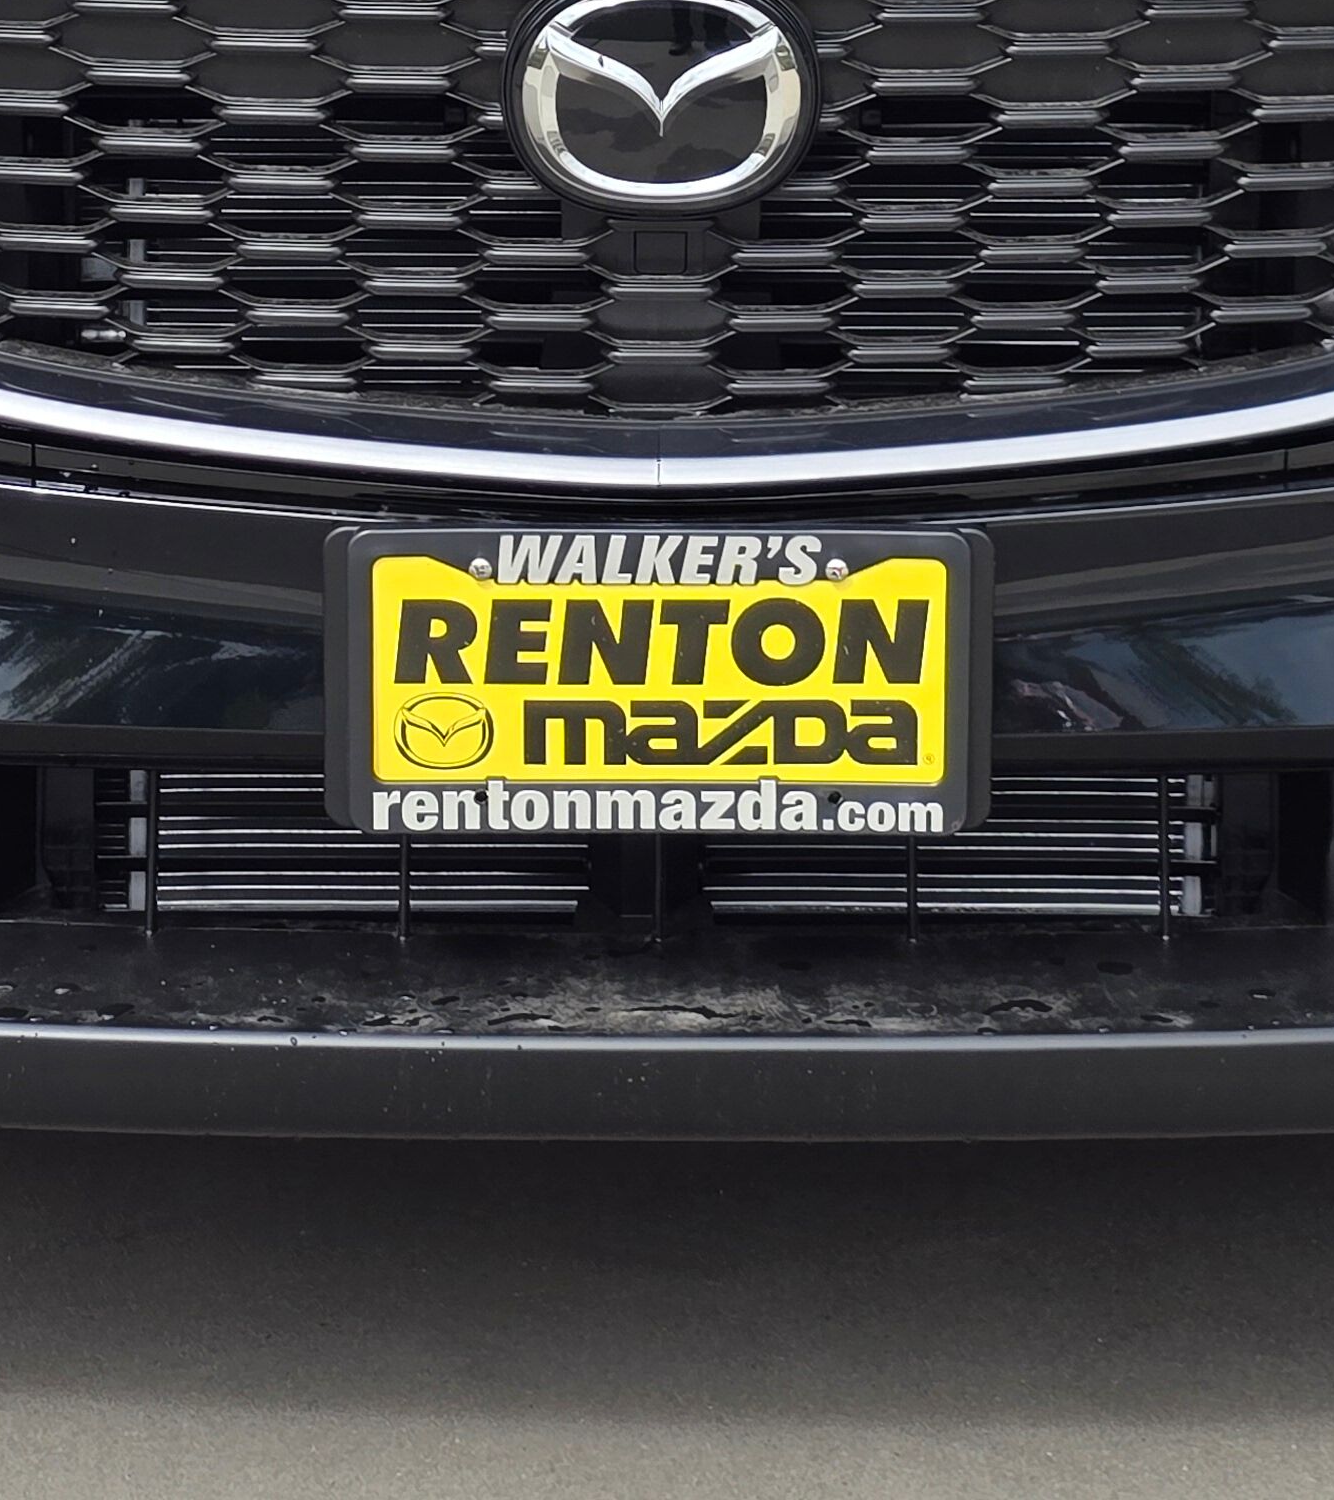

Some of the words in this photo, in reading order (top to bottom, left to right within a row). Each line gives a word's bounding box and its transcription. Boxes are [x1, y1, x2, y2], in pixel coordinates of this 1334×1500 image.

[497, 534, 822, 585] WALKER'S
[394, 597, 930, 685] RENTON
[523, 699, 919, 766] mazda
[372, 779, 945, 833] rentonmazda.com
